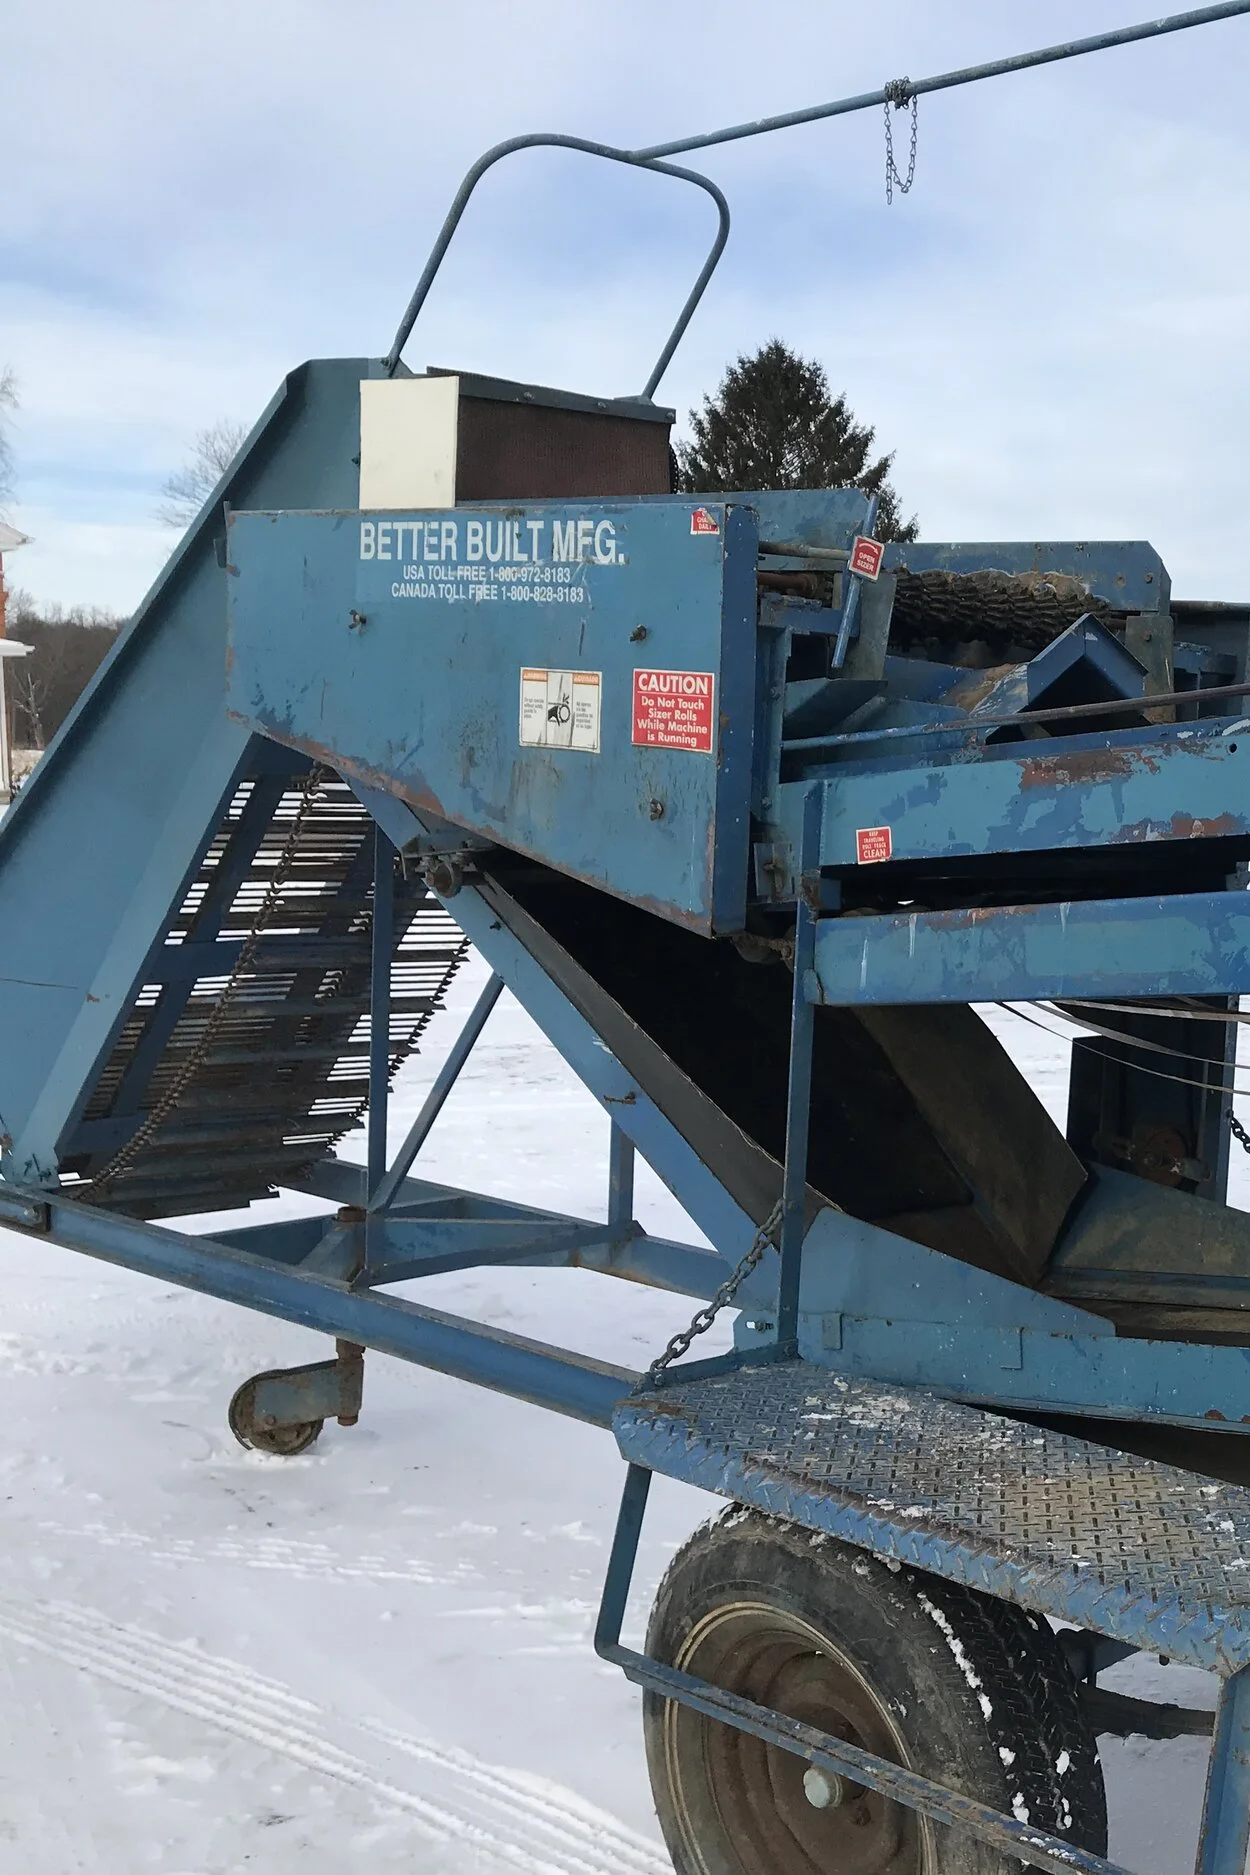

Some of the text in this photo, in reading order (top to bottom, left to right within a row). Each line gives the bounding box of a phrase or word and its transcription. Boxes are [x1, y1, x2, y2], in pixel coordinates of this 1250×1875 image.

[360, 519, 624, 563] BETTER BUILT MFG.
[859, 552, 875, 563] OPEN
[403, 565, 571, 582] USA TOLL FREE 1-800-972-8183
[391, 582, 583, 602] CANADA TOLL FREE 1-800-828-8183
[638, 673, 708, 695] CAUTION
[642, 696, 704, 710] Do Not Touch
[648, 708, 697, 721] Sizer Rolls
[637, 719, 707, 734] While Machine
[648, 731, 696, 747] is Running
[864, 849, 886, 859] CLEAN
